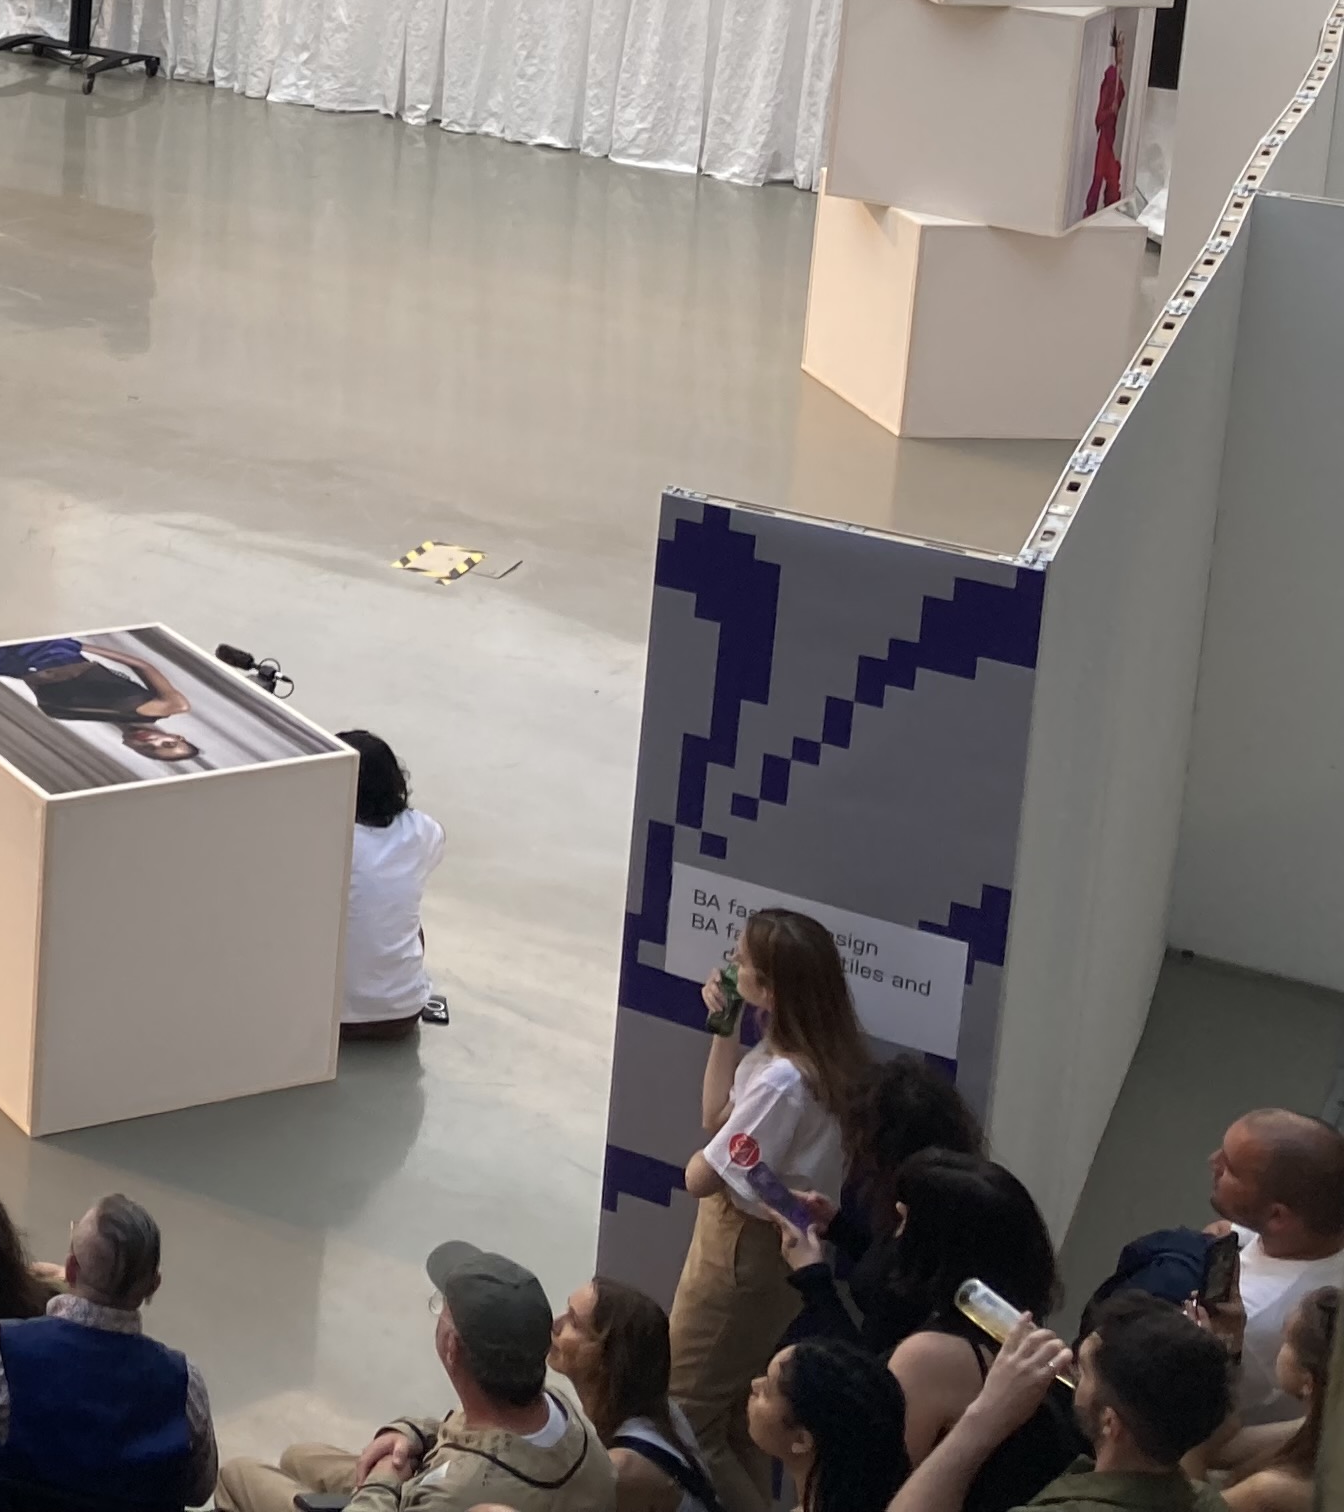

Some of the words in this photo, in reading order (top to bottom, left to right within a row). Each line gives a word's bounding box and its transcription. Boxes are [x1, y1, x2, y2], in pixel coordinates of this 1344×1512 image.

[691, 912, 719, 935] BA
[694, 889, 720, 911] BA
[832, 932, 878, 957] sign
[839, 956, 884, 983] tiles
[892, 975, 932, 997] and
